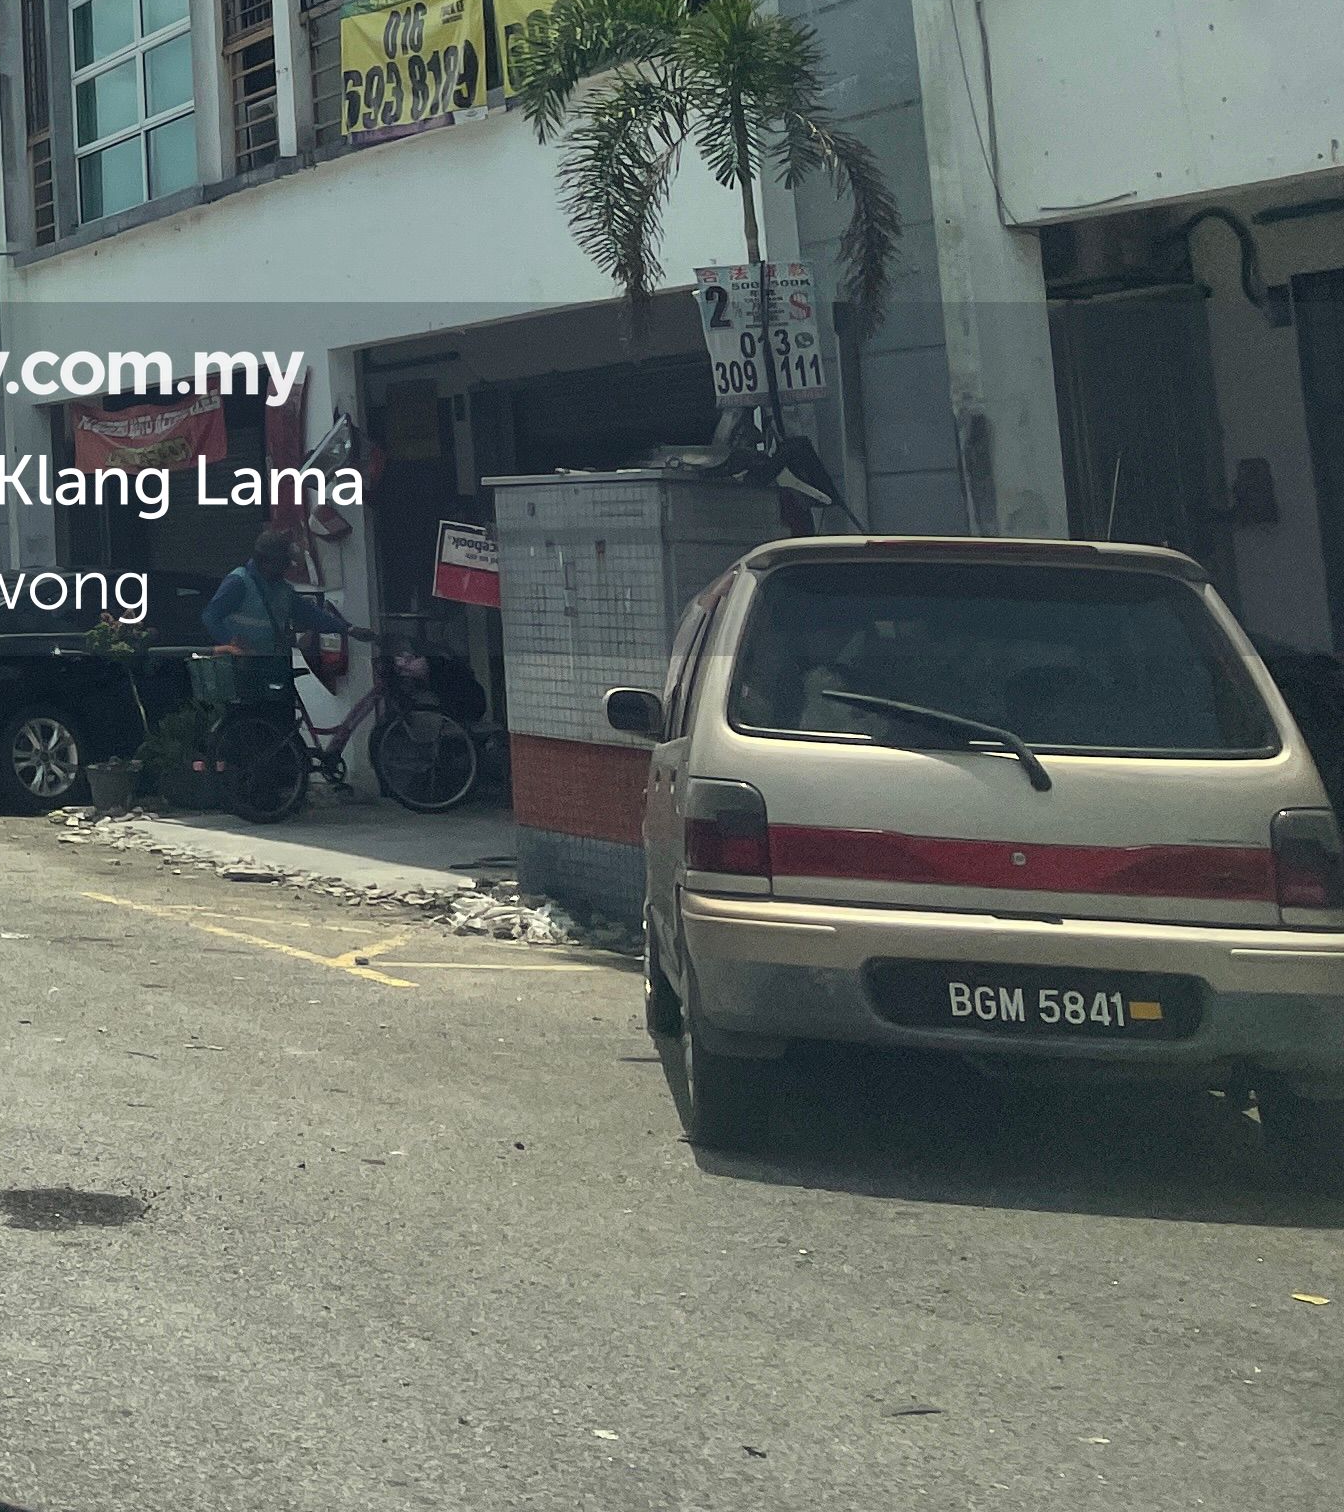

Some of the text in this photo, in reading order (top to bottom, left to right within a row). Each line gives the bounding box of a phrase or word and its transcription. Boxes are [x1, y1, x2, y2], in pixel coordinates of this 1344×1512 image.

[383, 2, 428, 60] 016
[705, 285, 731, 328] 2
[715, 359, 759, 395] 309
[948, 982, 1126, 1027] BGM 5841
